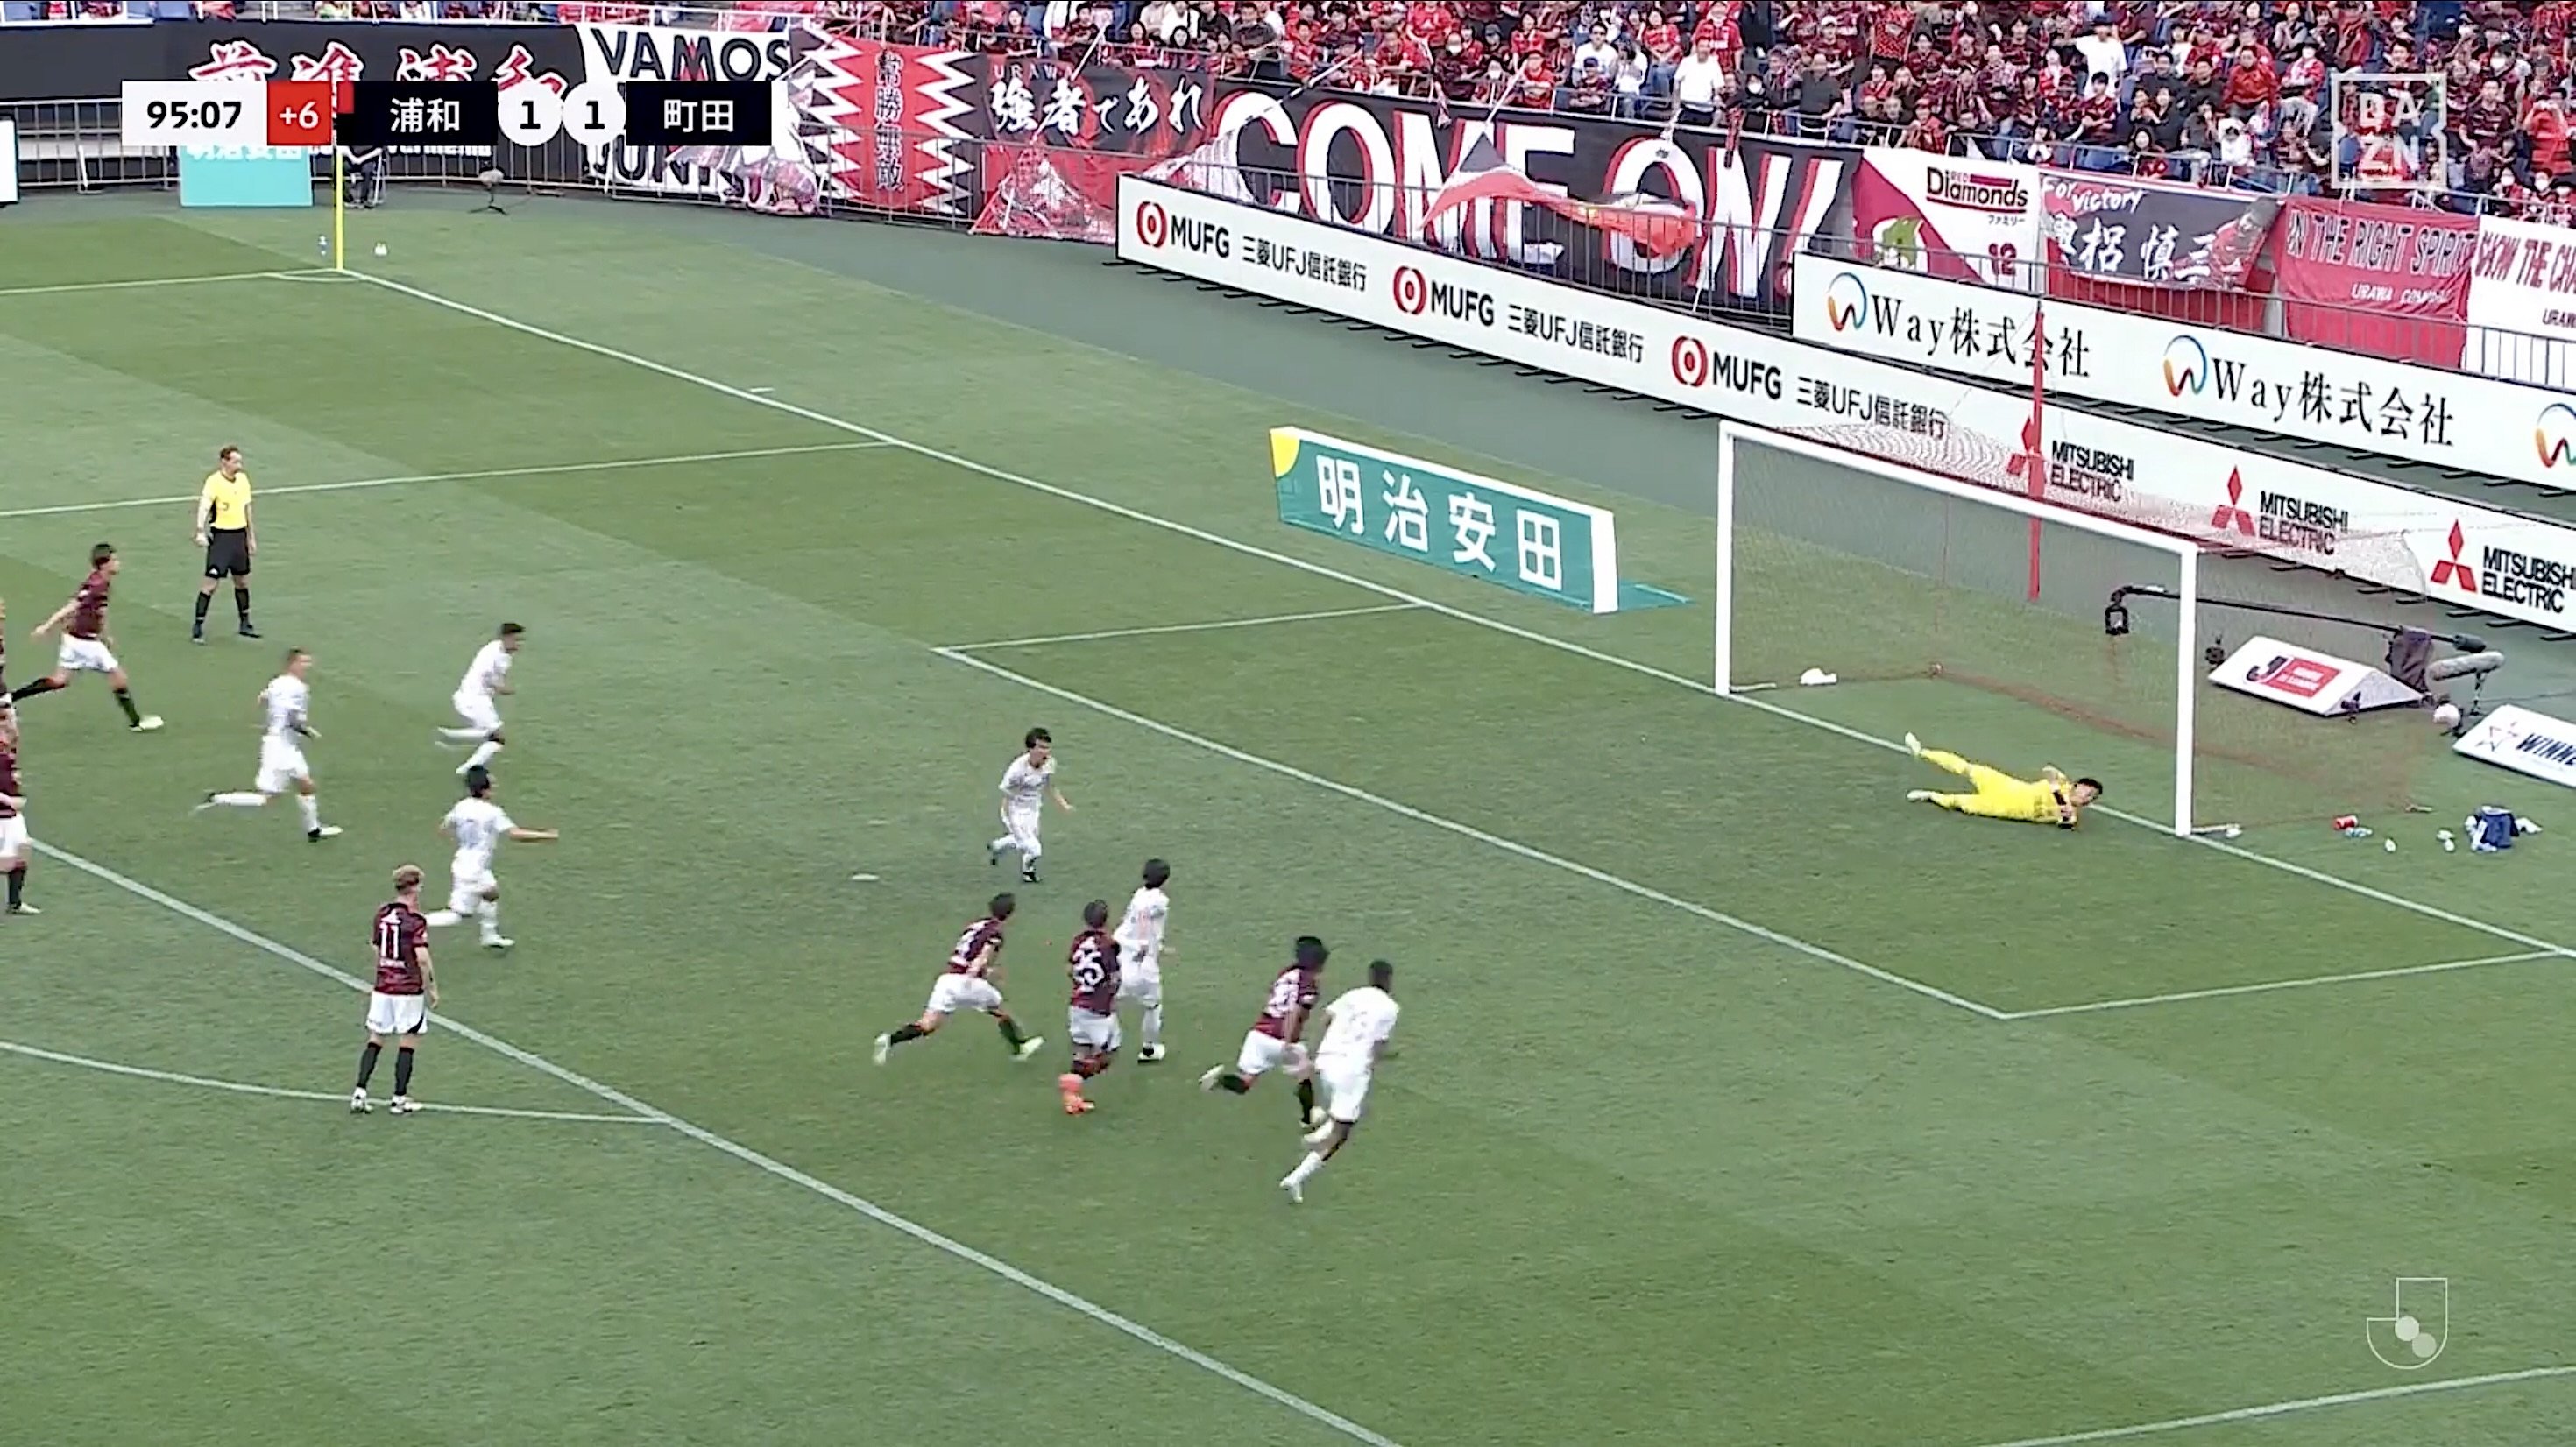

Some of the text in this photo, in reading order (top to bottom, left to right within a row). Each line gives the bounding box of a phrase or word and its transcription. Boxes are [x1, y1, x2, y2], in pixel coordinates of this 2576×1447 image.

[590, 27, 789, 82] VAMOS
[990, 75, 1206, 135] 強者であれ
[1212, 89, 1575, 265] COME
[1926, 166, 2029, 208] Diamonds
[1171, 215, 1368, 293] MUFG 三菱UFJ信託銀行
[1988, 243, 2017, 276] 12
[2310, 213, 2350, 265] THE
[2348, 218, 2414, 273] RIGHT
[2516, 237, 2553, 288] THE
[1431, 280, 1645, 364] MUFG 三菱UFJ信託銀行
[1872, 293, 2090, 378] Way株式会社
[1712, 351, 1947, 439] MUFG 三菱UFJ信託銀行
[2211, 357, 2455, 447] Way株式会社
[2050, 463, 2122, 502] ELECTRIC
[2051, 440, 2135, 481] MITSUBISHI
[1315, 454, 1563, 592] 明治安田
[2258, 515, 2336, 556] ELECTRIC
[2259, 490, 2349, 534] MITSUBISHI
[2481, 570, 2565, 613] ELECTRIC
[2482, 545, 2576, 591] MITSUBISH
[379, 921, 400, 960] 11
